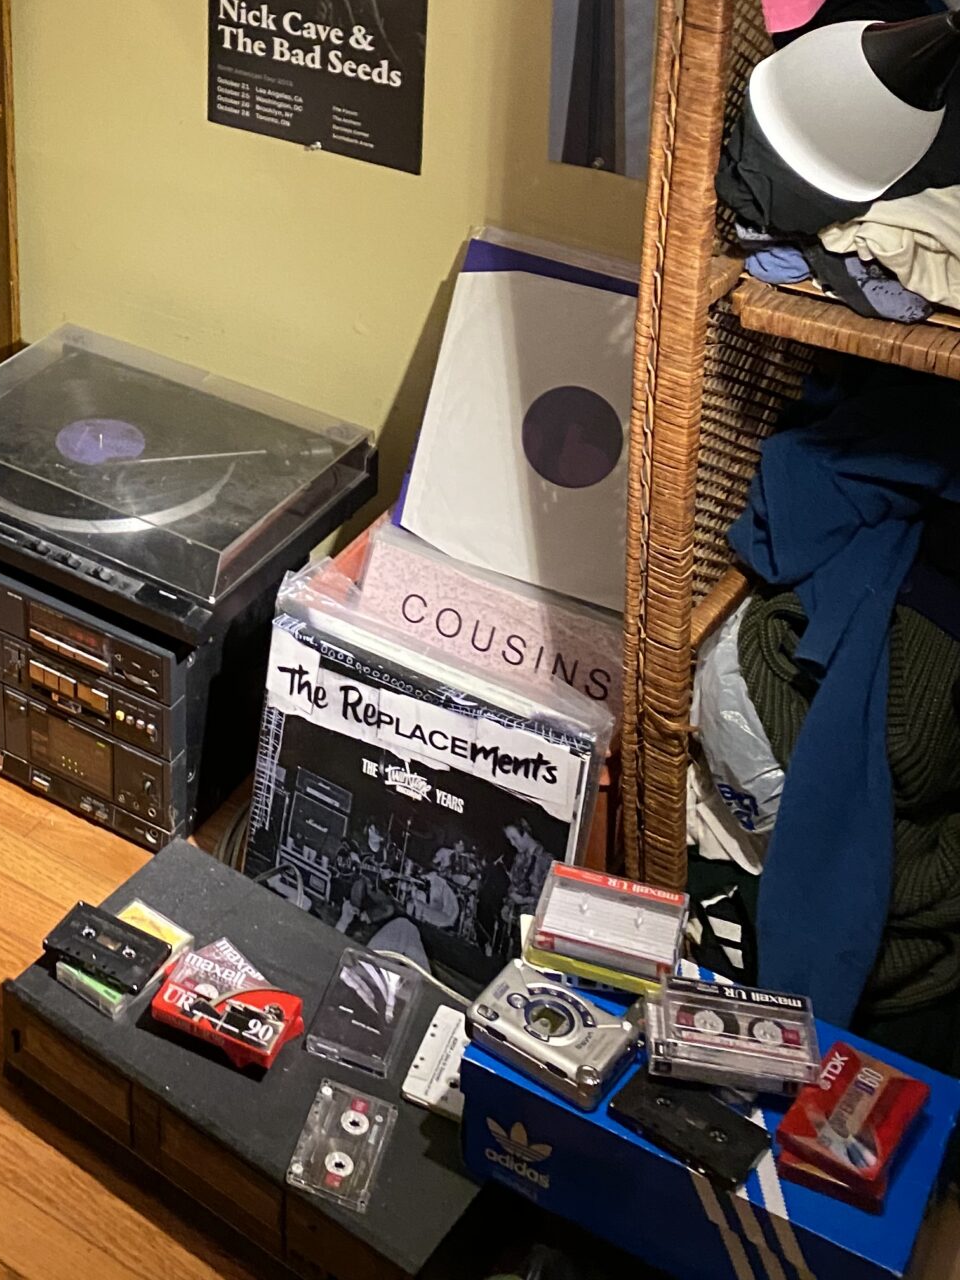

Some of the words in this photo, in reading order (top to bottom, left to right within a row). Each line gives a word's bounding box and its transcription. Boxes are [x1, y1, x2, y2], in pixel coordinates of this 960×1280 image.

[282, 11, 344, 44] Cave
[348, 24, 376, 51] &
[217, 24, 267, 56] The
[272, 36, 323, 69] Bad
[328, 50, 402, 87] Seeds
[401, 592, 611, 702] COUSINS
[278, 664, 328, 715] The
[361, 758, 379, 778] THE
[435, 788, 464, 814] YEARS
[185, 952, 248, 990] maxell
[722, 985, 747, 1000] UR
[751, 991, 802, 1008] maxell
[247, 1019, 274, 1041] 90
[824, 1054, 848, 1082] TDK
[484, 1147, 551, 1189] adidas
